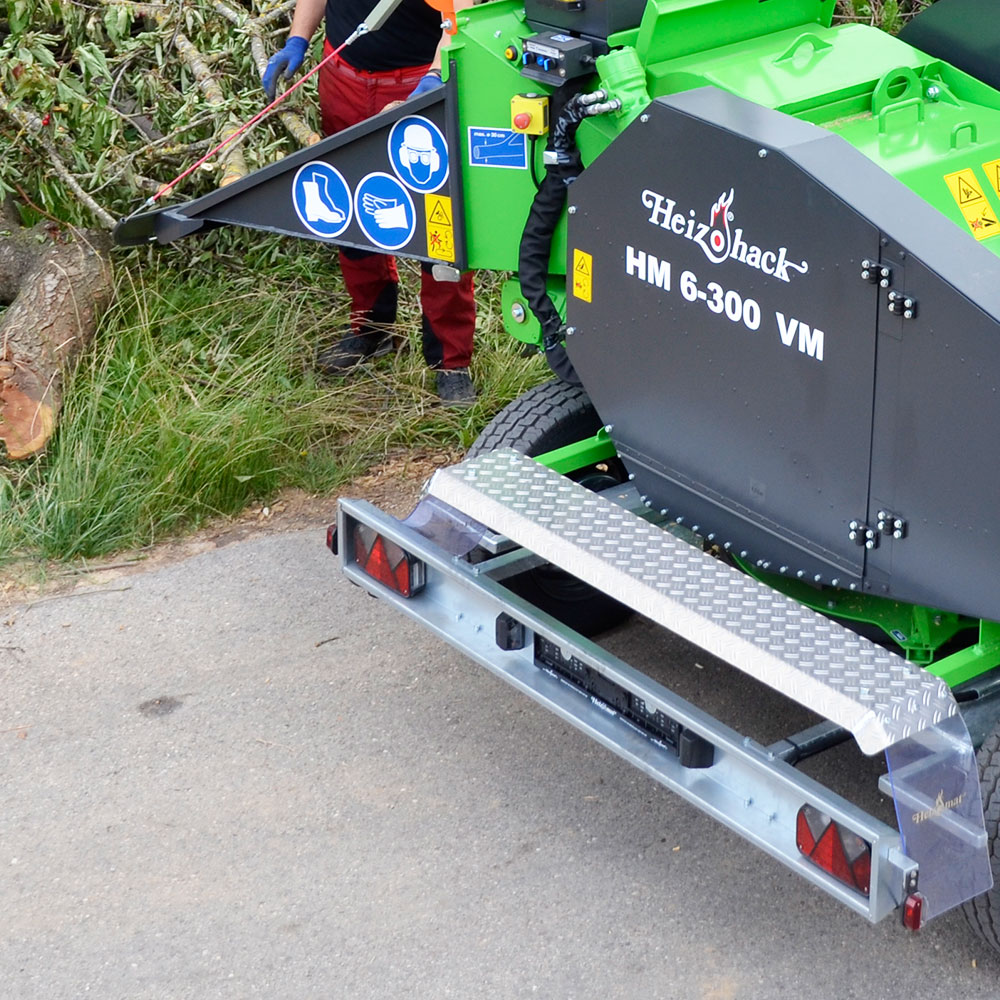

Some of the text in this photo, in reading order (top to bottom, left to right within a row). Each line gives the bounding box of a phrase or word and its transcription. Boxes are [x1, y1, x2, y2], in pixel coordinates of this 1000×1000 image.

[641, 188, 808, 283] Heizohack
[625, 245, 825, 362] HM 6-300 VM
